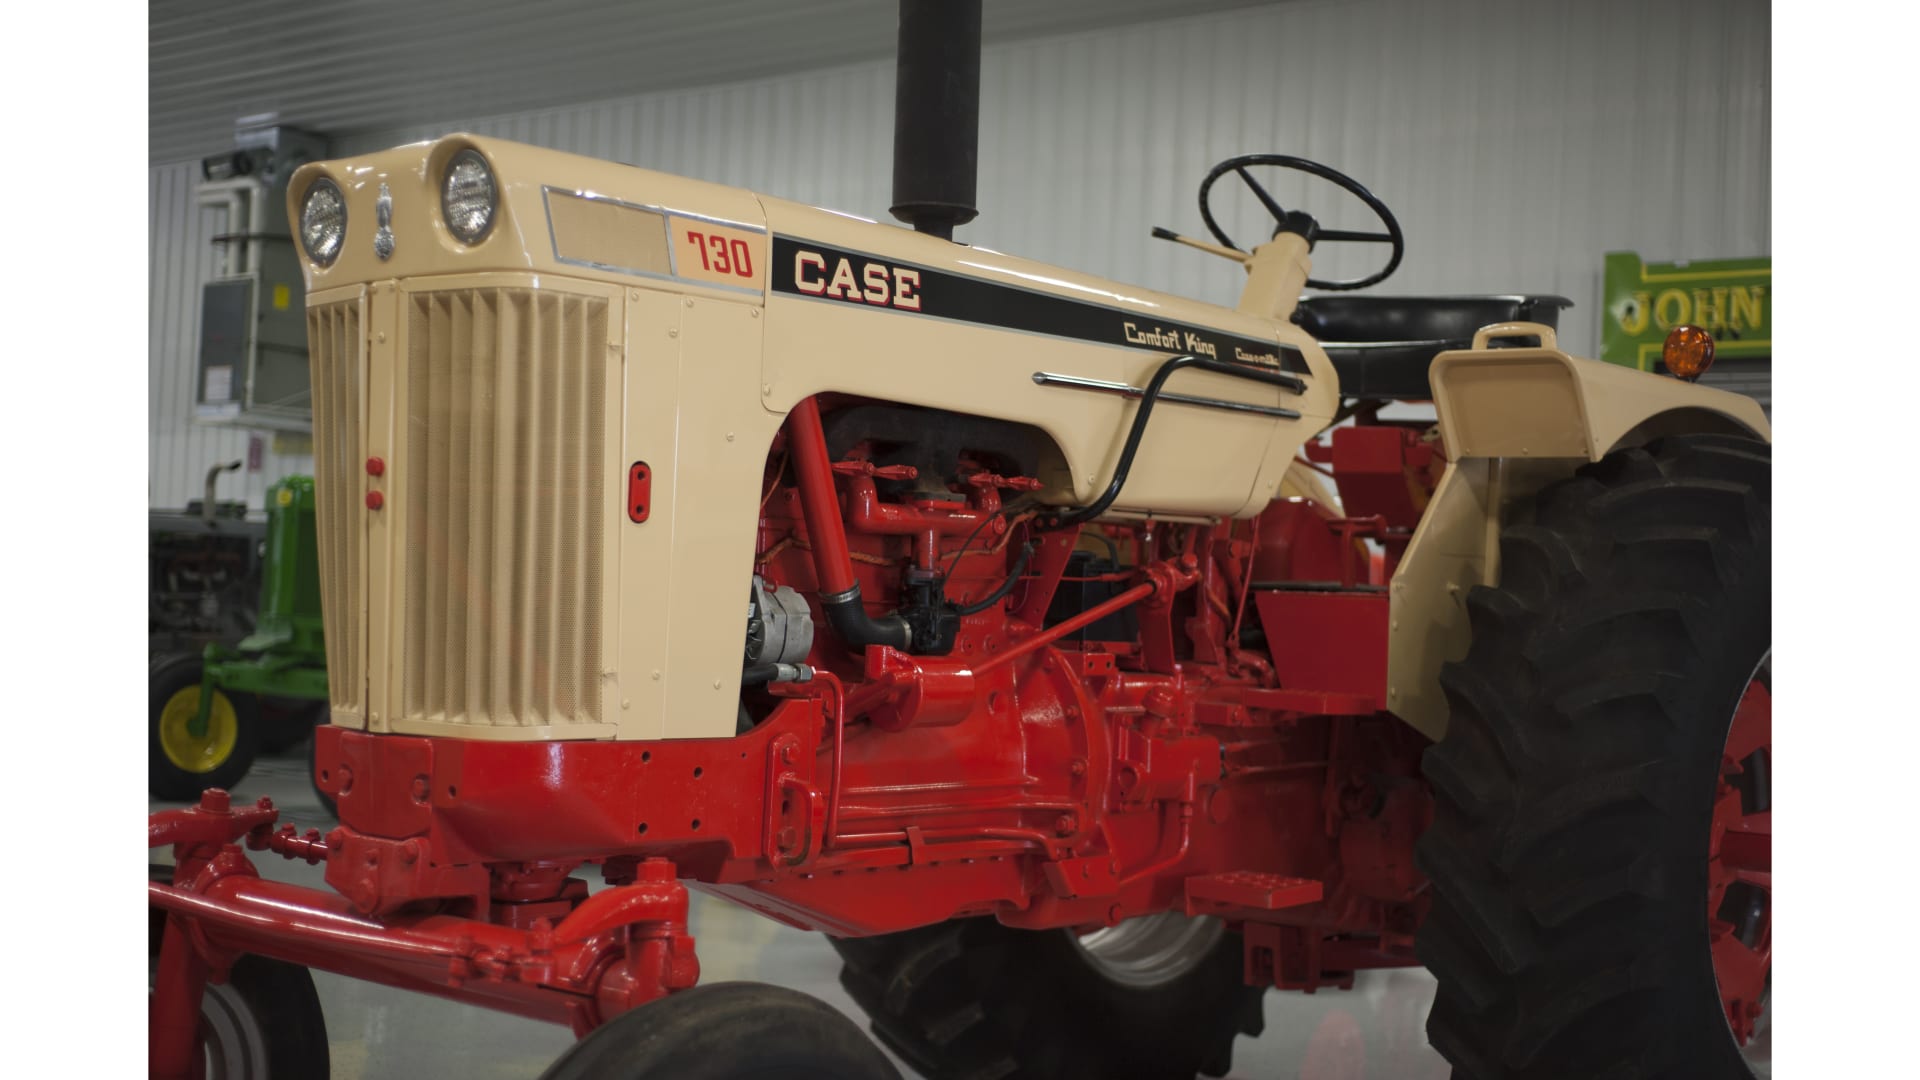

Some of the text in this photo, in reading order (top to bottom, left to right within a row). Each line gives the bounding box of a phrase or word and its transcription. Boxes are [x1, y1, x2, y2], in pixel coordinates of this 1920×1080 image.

[687, 231, 753, 278] 730
[794, 250, 921, 311] CASE
[1621, 286, 1766, 336] JOHN
[1123, 321, 1182, 350] Comfort
[1184, 332, 1218, 361] King
